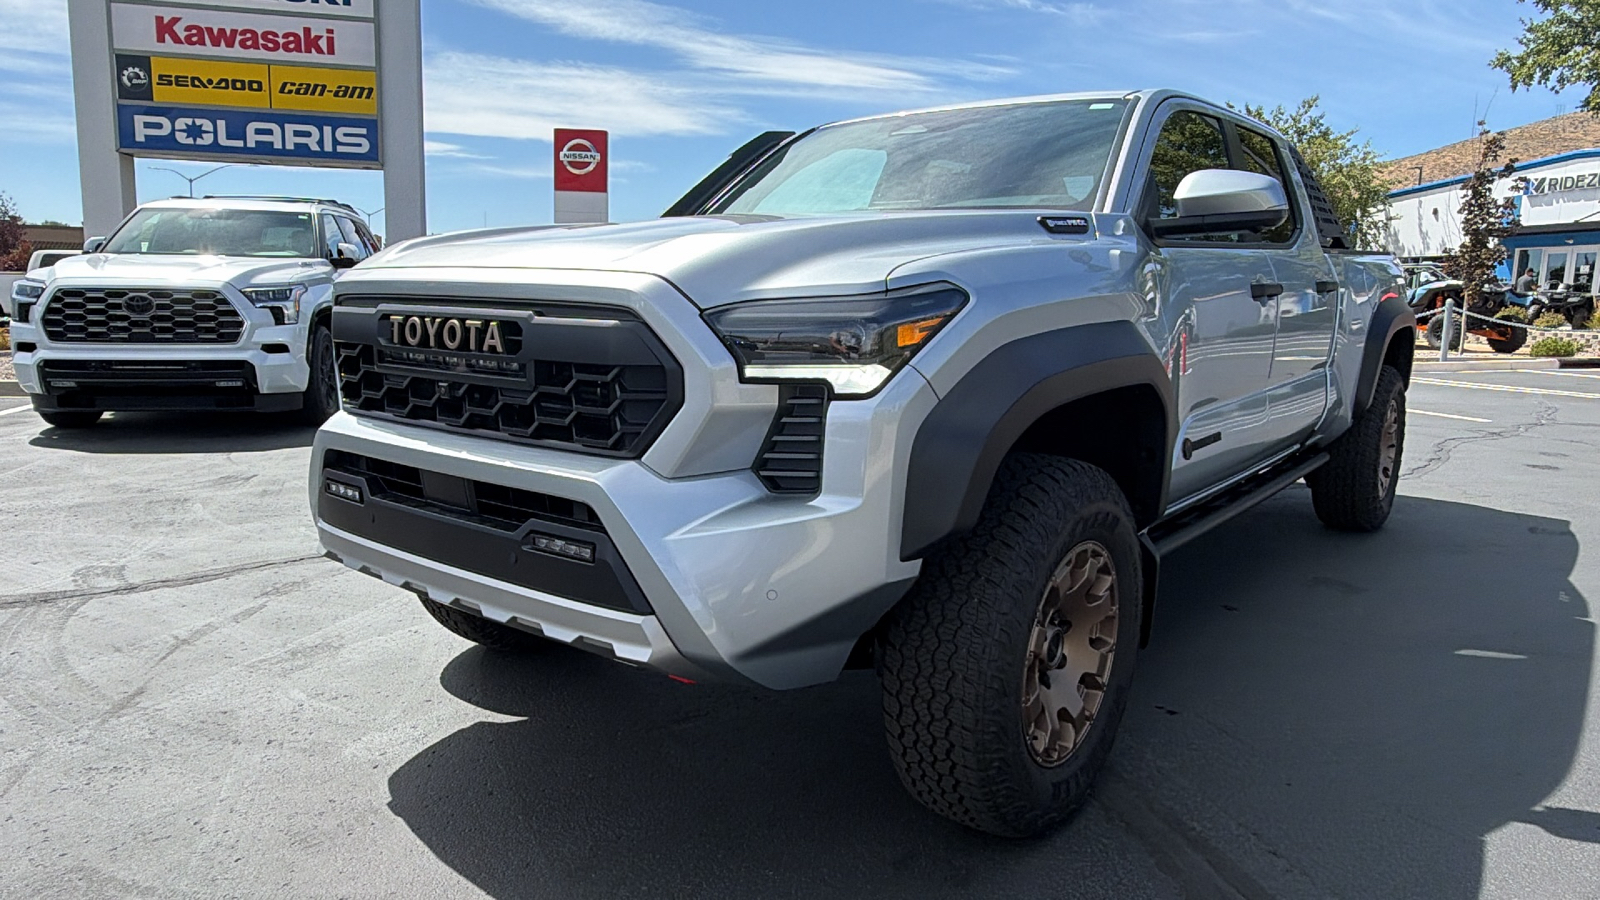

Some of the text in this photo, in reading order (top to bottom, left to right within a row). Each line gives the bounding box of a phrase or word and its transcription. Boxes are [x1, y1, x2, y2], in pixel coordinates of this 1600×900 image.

[155, 16, 336, 55] Kawasaki
[133, 114, 370, 154] POLARIS
[1548, 173, 1600, 191] RIDEZ
[390, 315, 504, 353] TOYOTA
